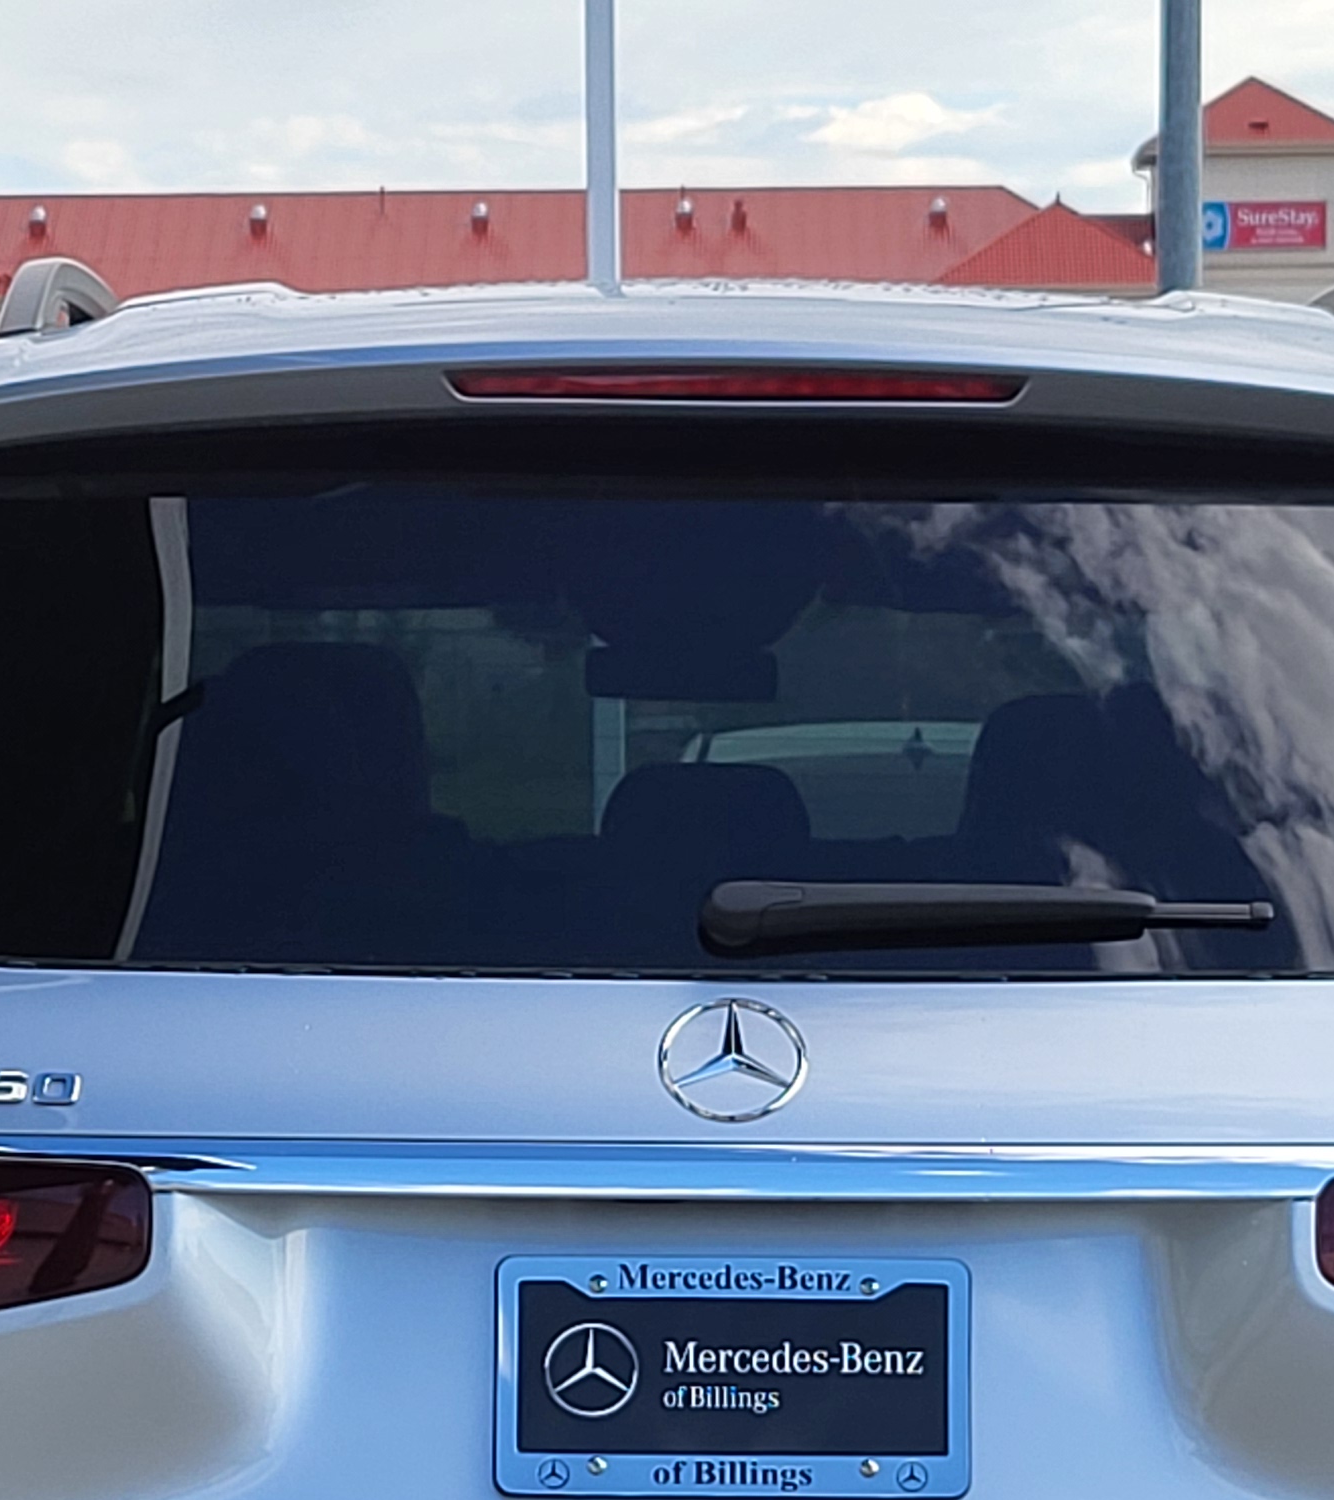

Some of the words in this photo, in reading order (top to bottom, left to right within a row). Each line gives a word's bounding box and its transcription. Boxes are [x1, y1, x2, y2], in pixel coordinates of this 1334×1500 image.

[1237, 207, 1317, 229] SureStay
[618, 1263, 852, 1291] Mercedes-Benz
[663, 1340, 924, 1376] Mercedes-Benz
[663, 1385, 688, 1409] of
[690, 1386, 780, 1414] Billings
[653, 1461, 688, 1486] of
[694, 1461, 814, 1492] Billings
